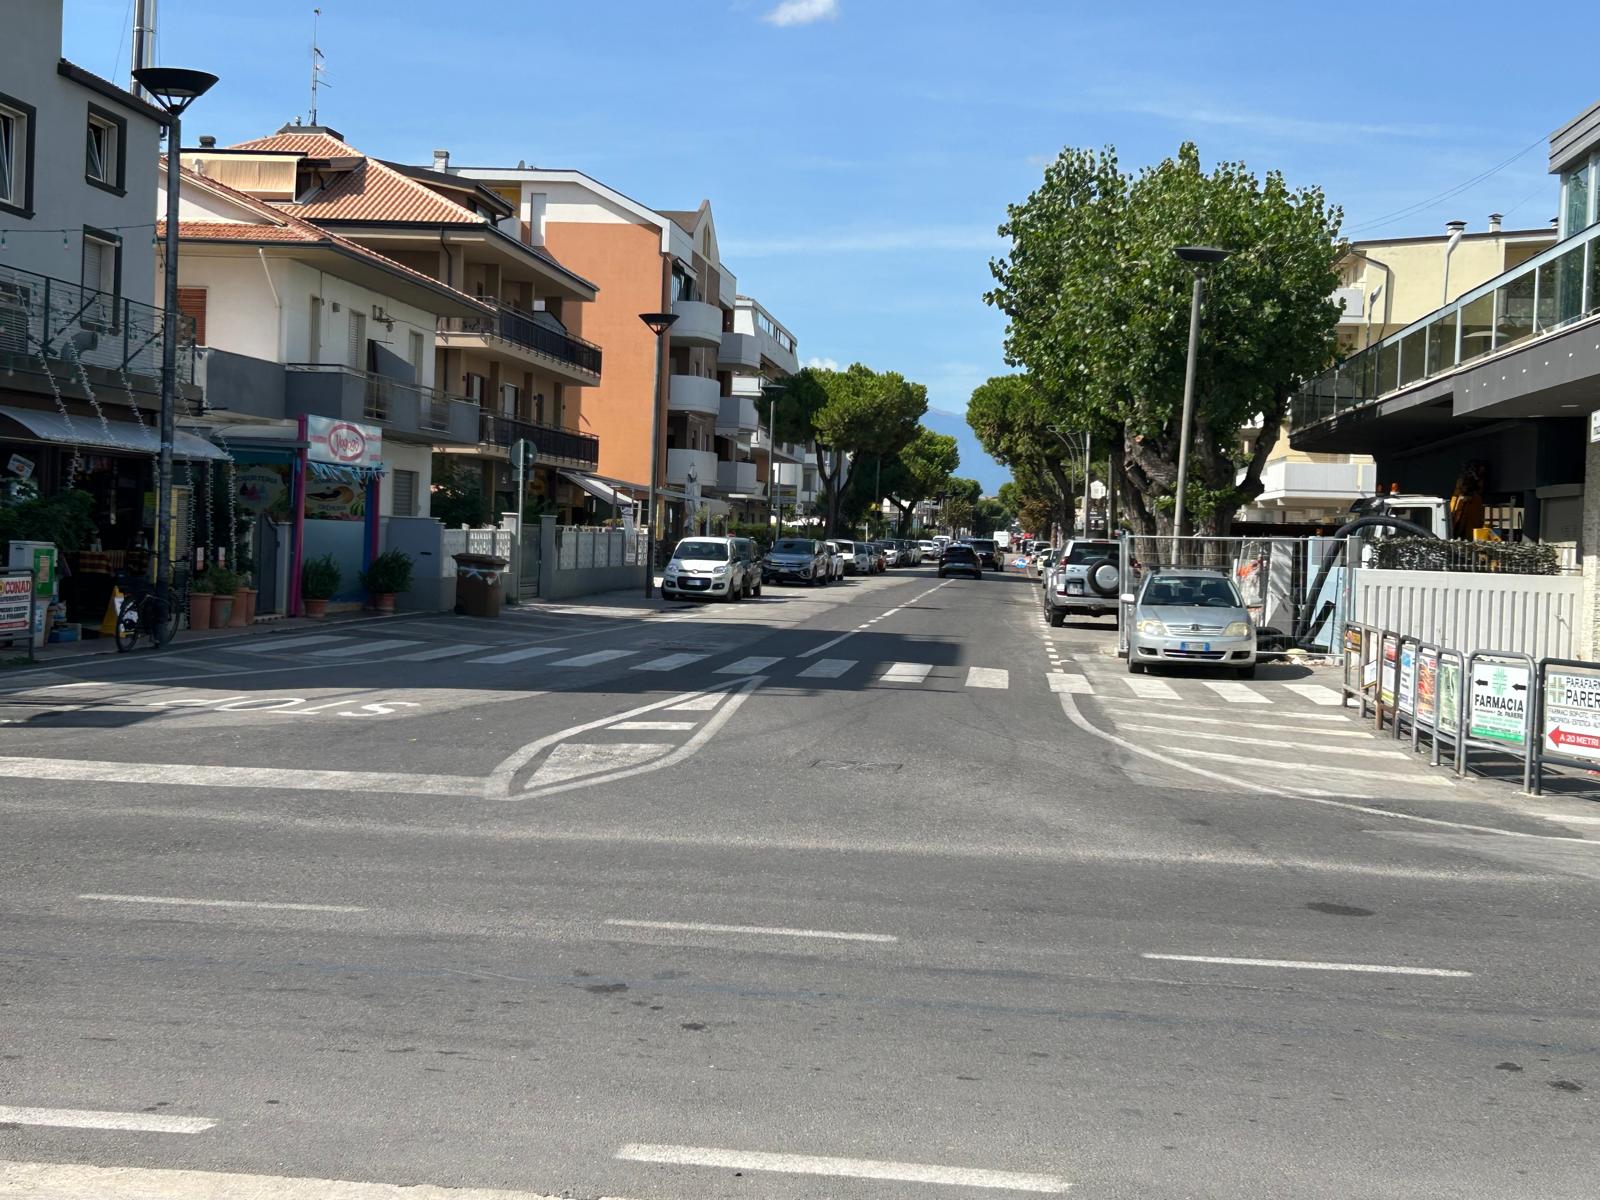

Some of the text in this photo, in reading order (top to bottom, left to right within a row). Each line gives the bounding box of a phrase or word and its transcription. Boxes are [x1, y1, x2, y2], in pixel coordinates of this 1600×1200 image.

[6, 580, 32, 594] CONAD
[148, 695, 421, 718] STOP
[1475, 694, 1523, 712] FARMACIA
[1560, 734, 1599, 747] A 20 METRI
